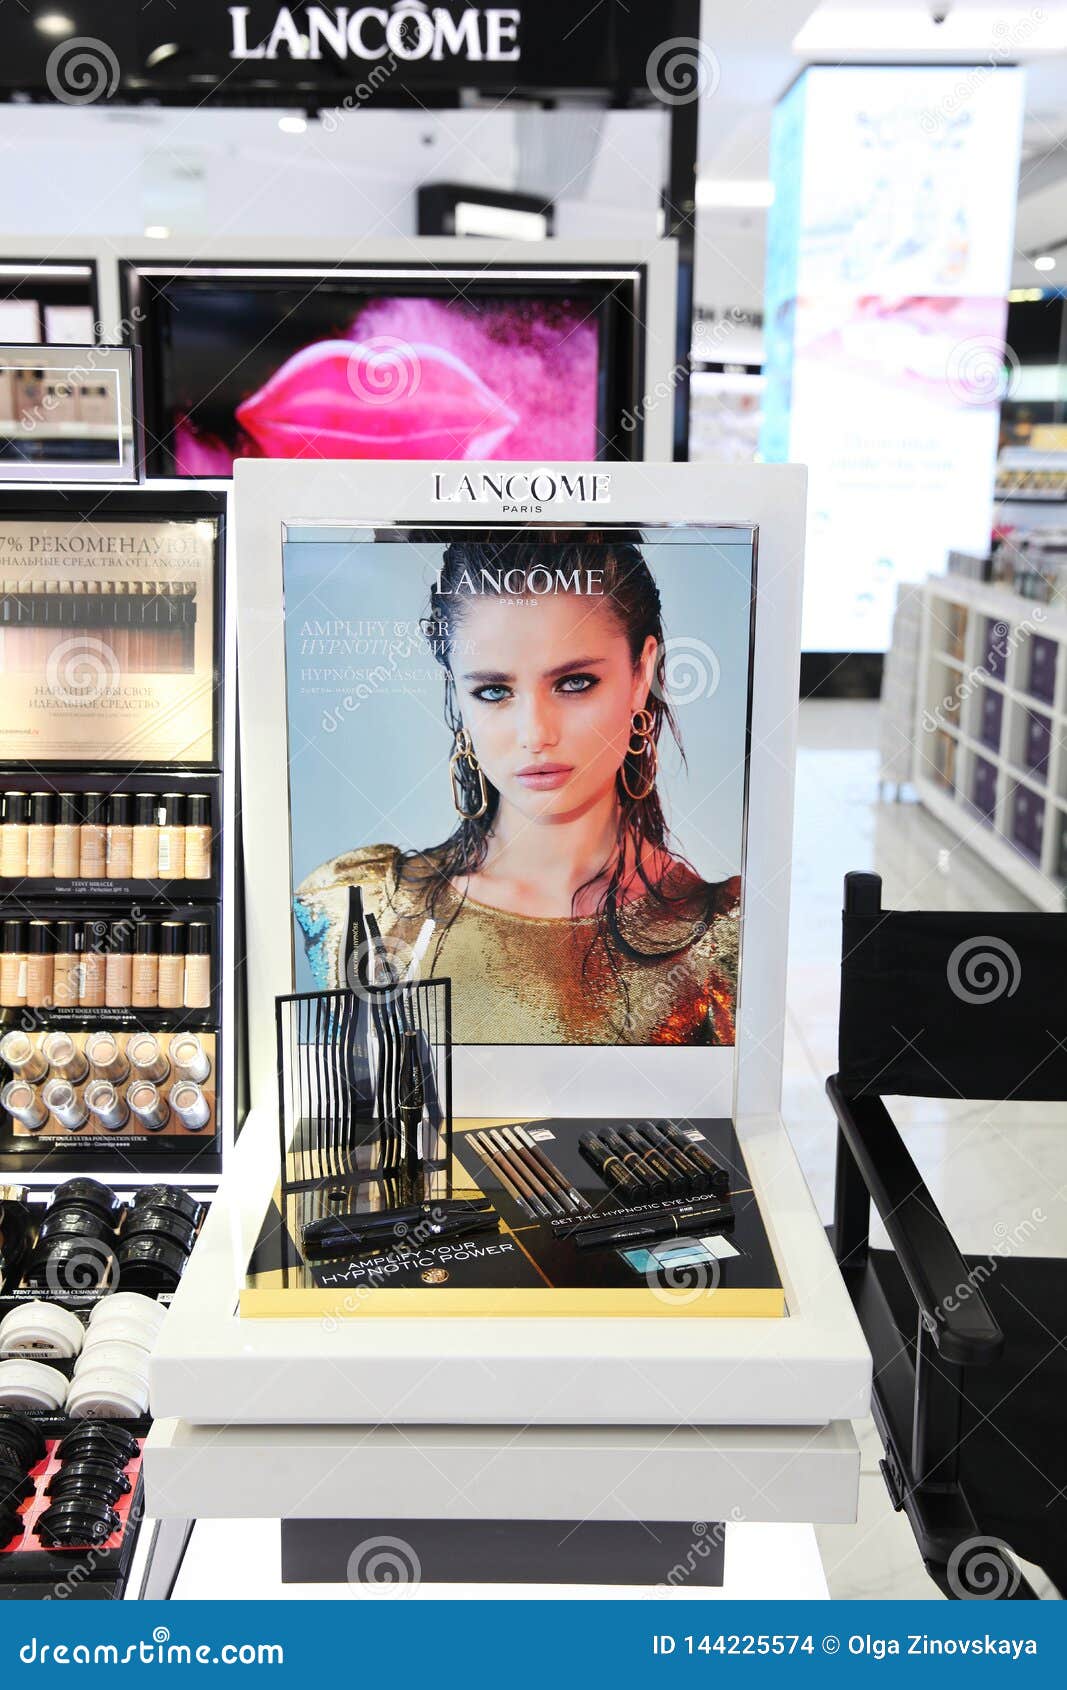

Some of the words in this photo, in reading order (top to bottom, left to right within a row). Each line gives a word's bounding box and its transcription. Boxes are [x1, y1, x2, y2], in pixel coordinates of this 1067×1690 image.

[229, 0, 521, 61] LANCÔME
[502, 505, 542, 513] PARIS
[30, 536, 199, 554] РЕКОМЕНДУЮТ
[0, 557, 61, 567] НАЛЬНЫЕ
[63, 557, 123, 567] СРЕДСТВА
[434, 563, 604, 595] LANCÔME
[300, 620, 386, 637] AMPLIFY
[551, 1217, 573, 1226] GET
[576, 1213, 600, 1222] THE
[603, 1203, 660, 1217] HYPNOTIC
[662, 1199, 684, 1208] EYE
[685, 1193, 717, 1204] LOOK
[321, 1258, 434, 1284] HYPNOTIC
[440, 1243, 515, 1263] POWER
[348, 1250, 421, 1271] AMPLIFY
[425, 1241, 477, 1256] YOUR
